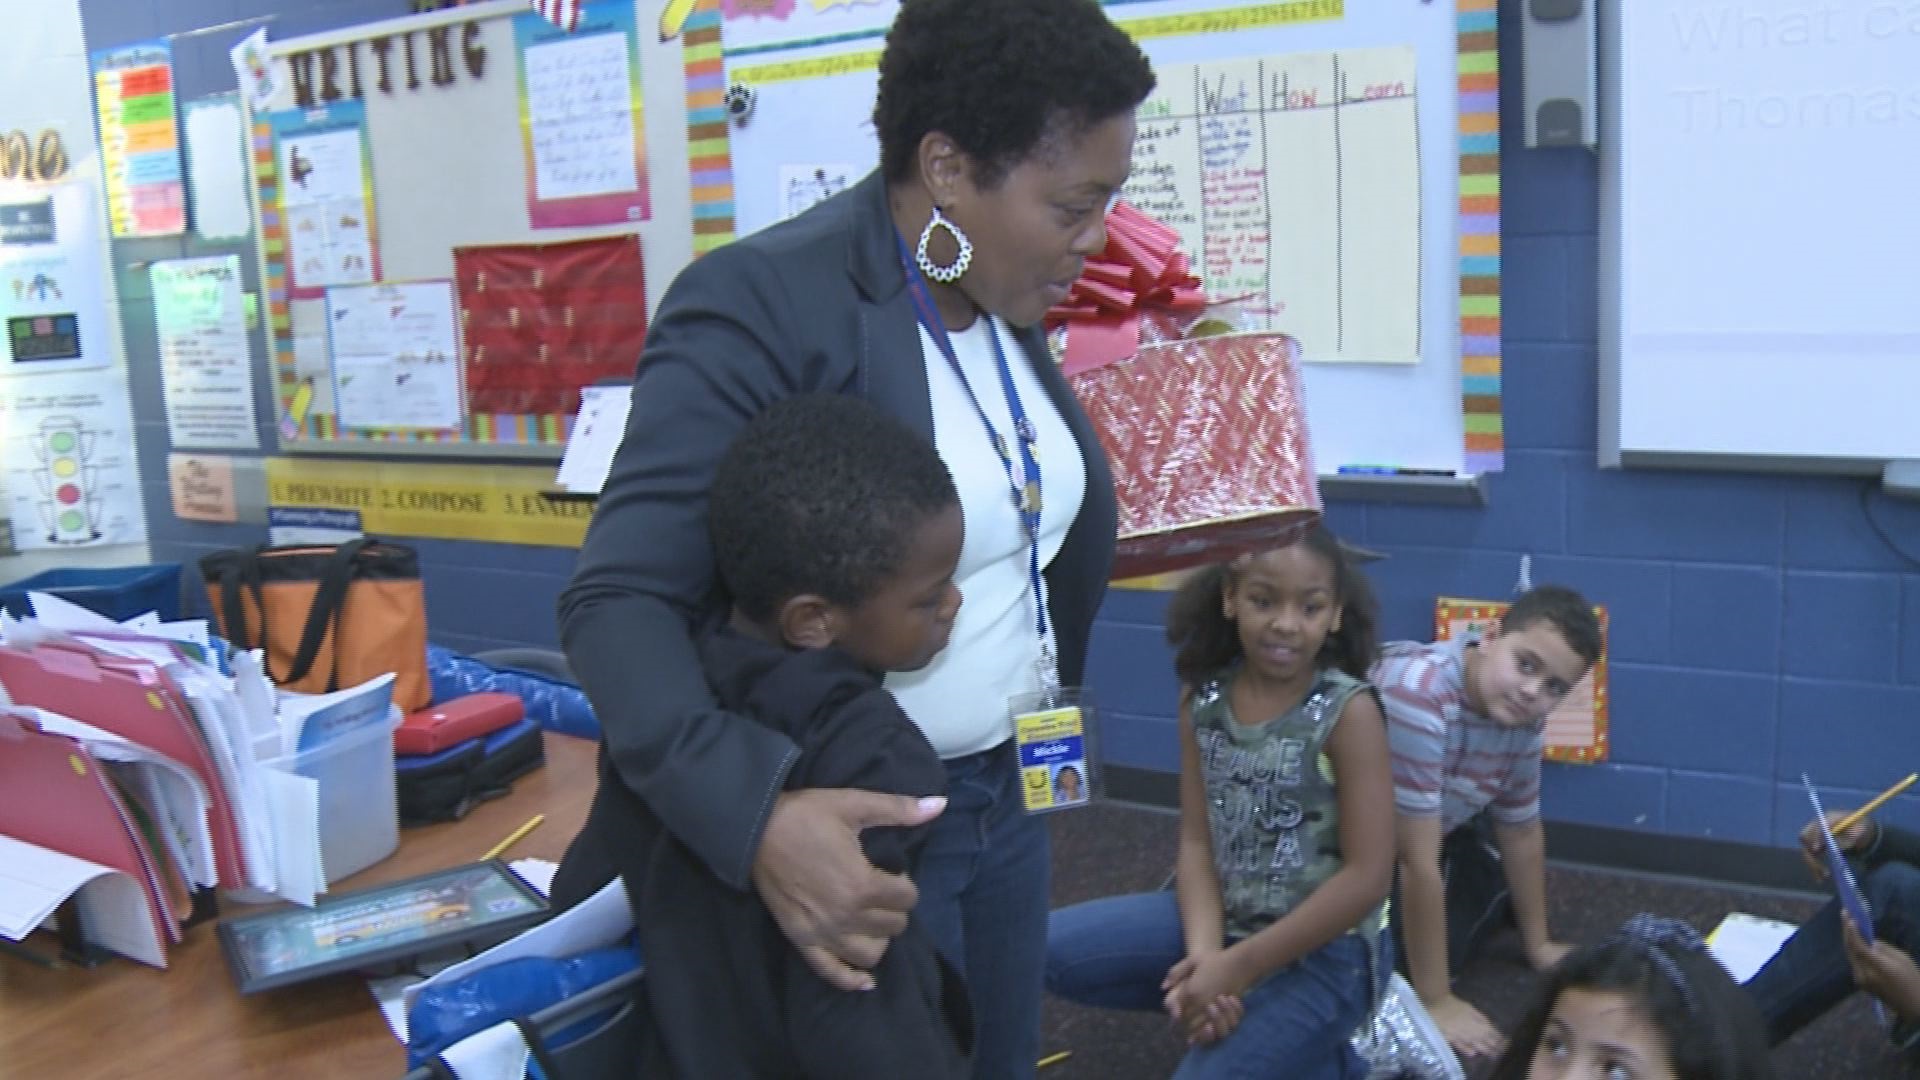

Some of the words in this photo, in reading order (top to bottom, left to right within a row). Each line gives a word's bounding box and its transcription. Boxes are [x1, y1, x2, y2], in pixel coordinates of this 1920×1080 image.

[1671, 4, 1845, 52] What
[286, 20, 485, 108] WRITING
[287, 484, 373, 508] PREWRITE
[399, 490, 487, 513] COMPOSE
